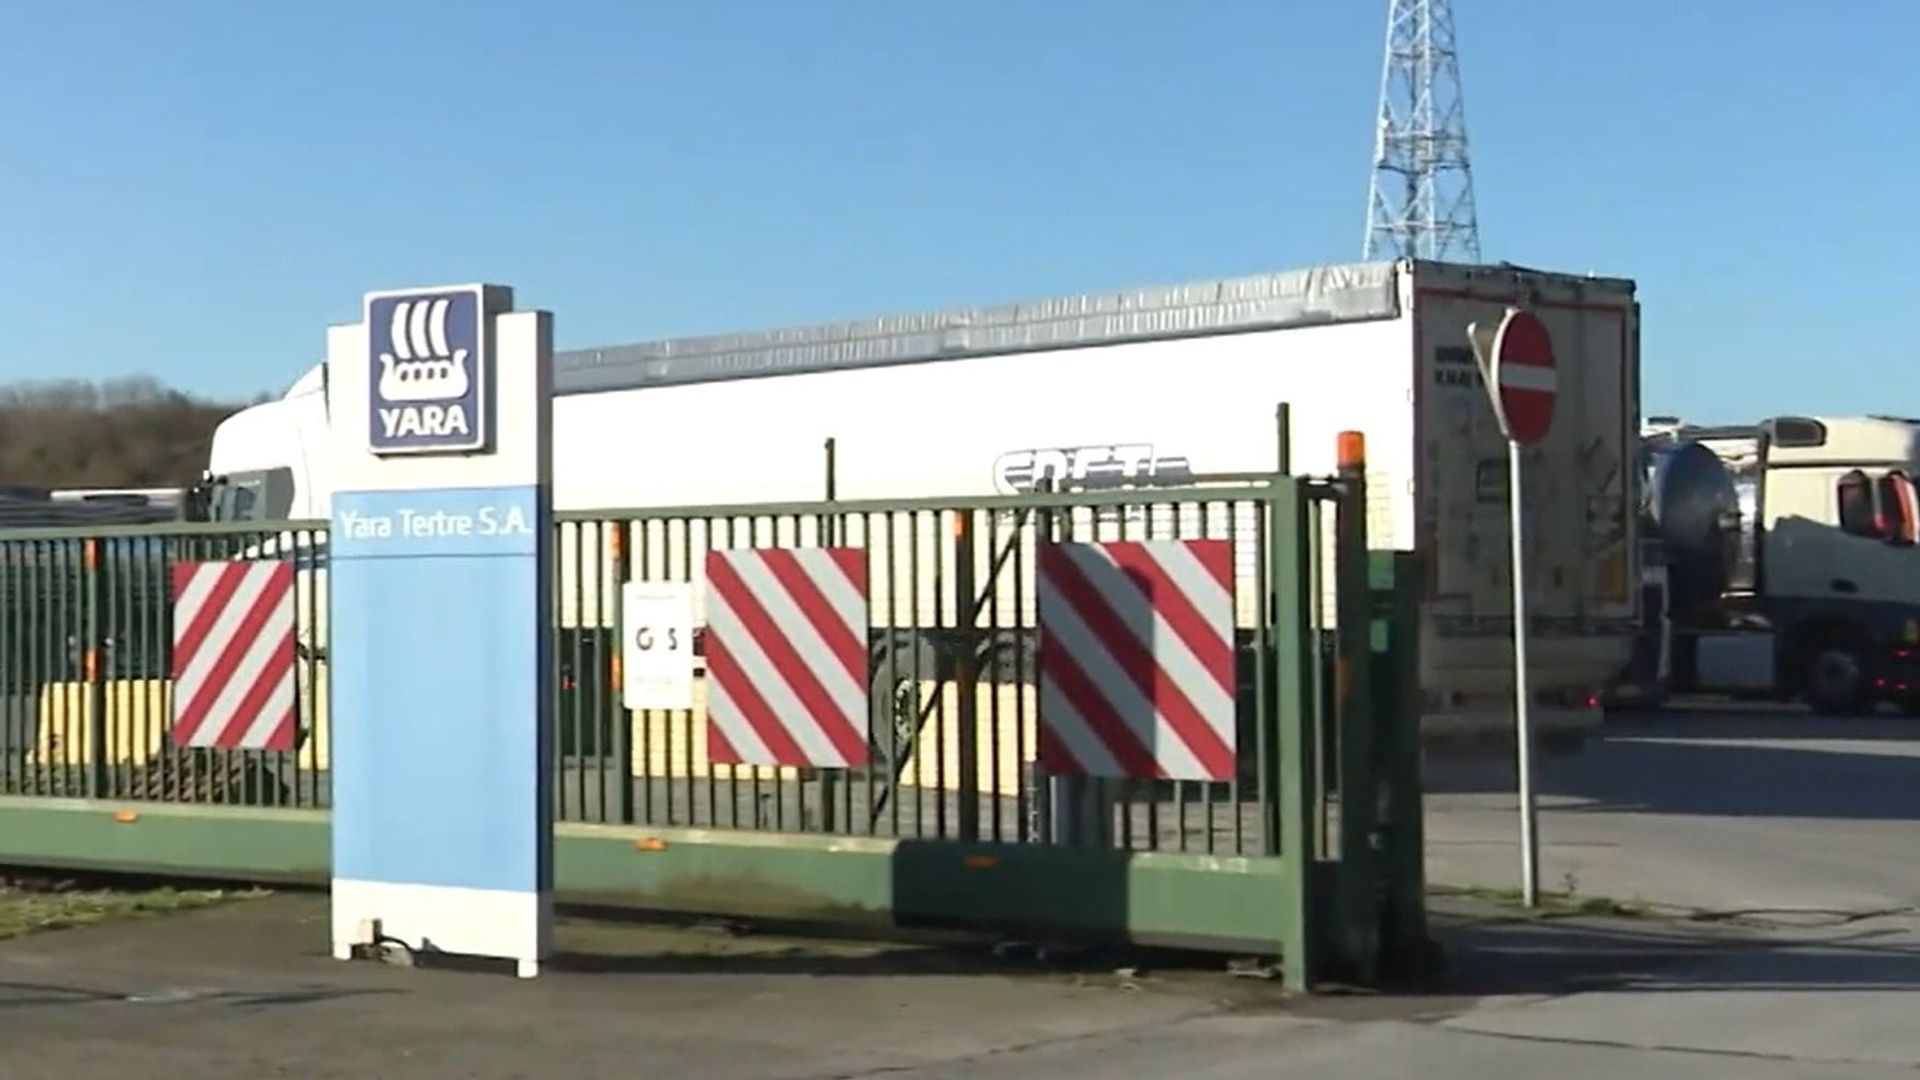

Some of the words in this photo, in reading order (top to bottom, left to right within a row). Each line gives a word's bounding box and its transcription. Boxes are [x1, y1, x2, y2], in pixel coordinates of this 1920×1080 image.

[378, 404, 469, 438] YARA
[340, 510, 391, 538] Yara
[397, 510, 473, 537] Tertre
